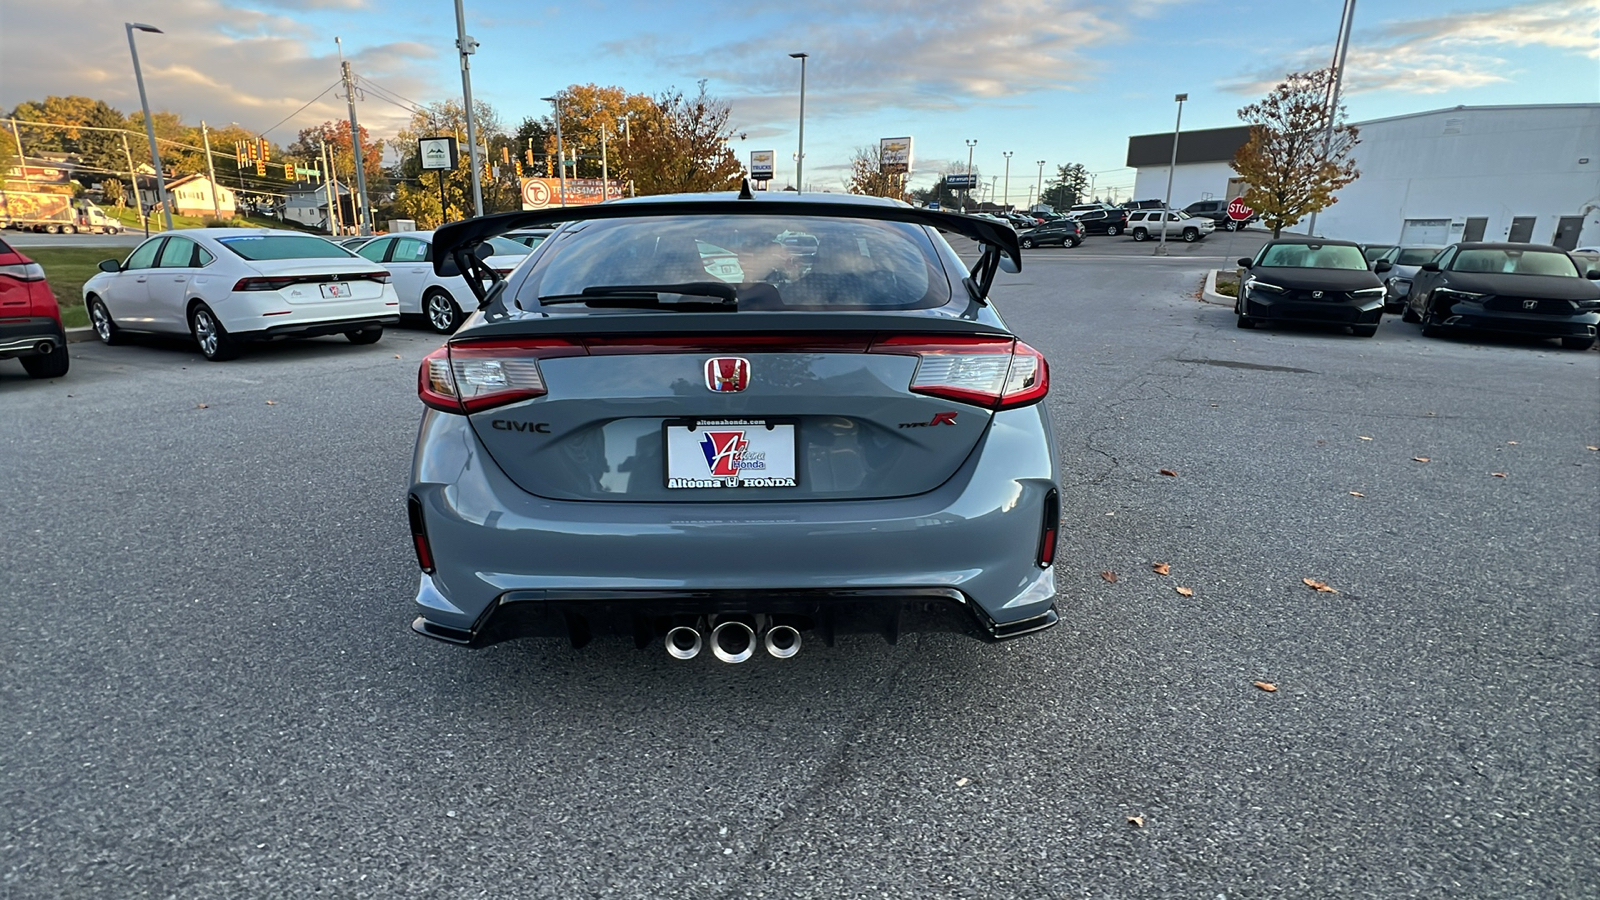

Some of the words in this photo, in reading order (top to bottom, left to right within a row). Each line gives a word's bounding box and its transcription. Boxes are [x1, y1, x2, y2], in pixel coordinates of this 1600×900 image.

[552, 186, 622, 195] TRANS4MATON
[928, 411, 958, 427] R
[492, 419, 551, 434] CIVIC
[733, 459, 766, 470] Honda
[668, 478, 721, 489] Altoona
[743, 478, 796, 488] HONDA
